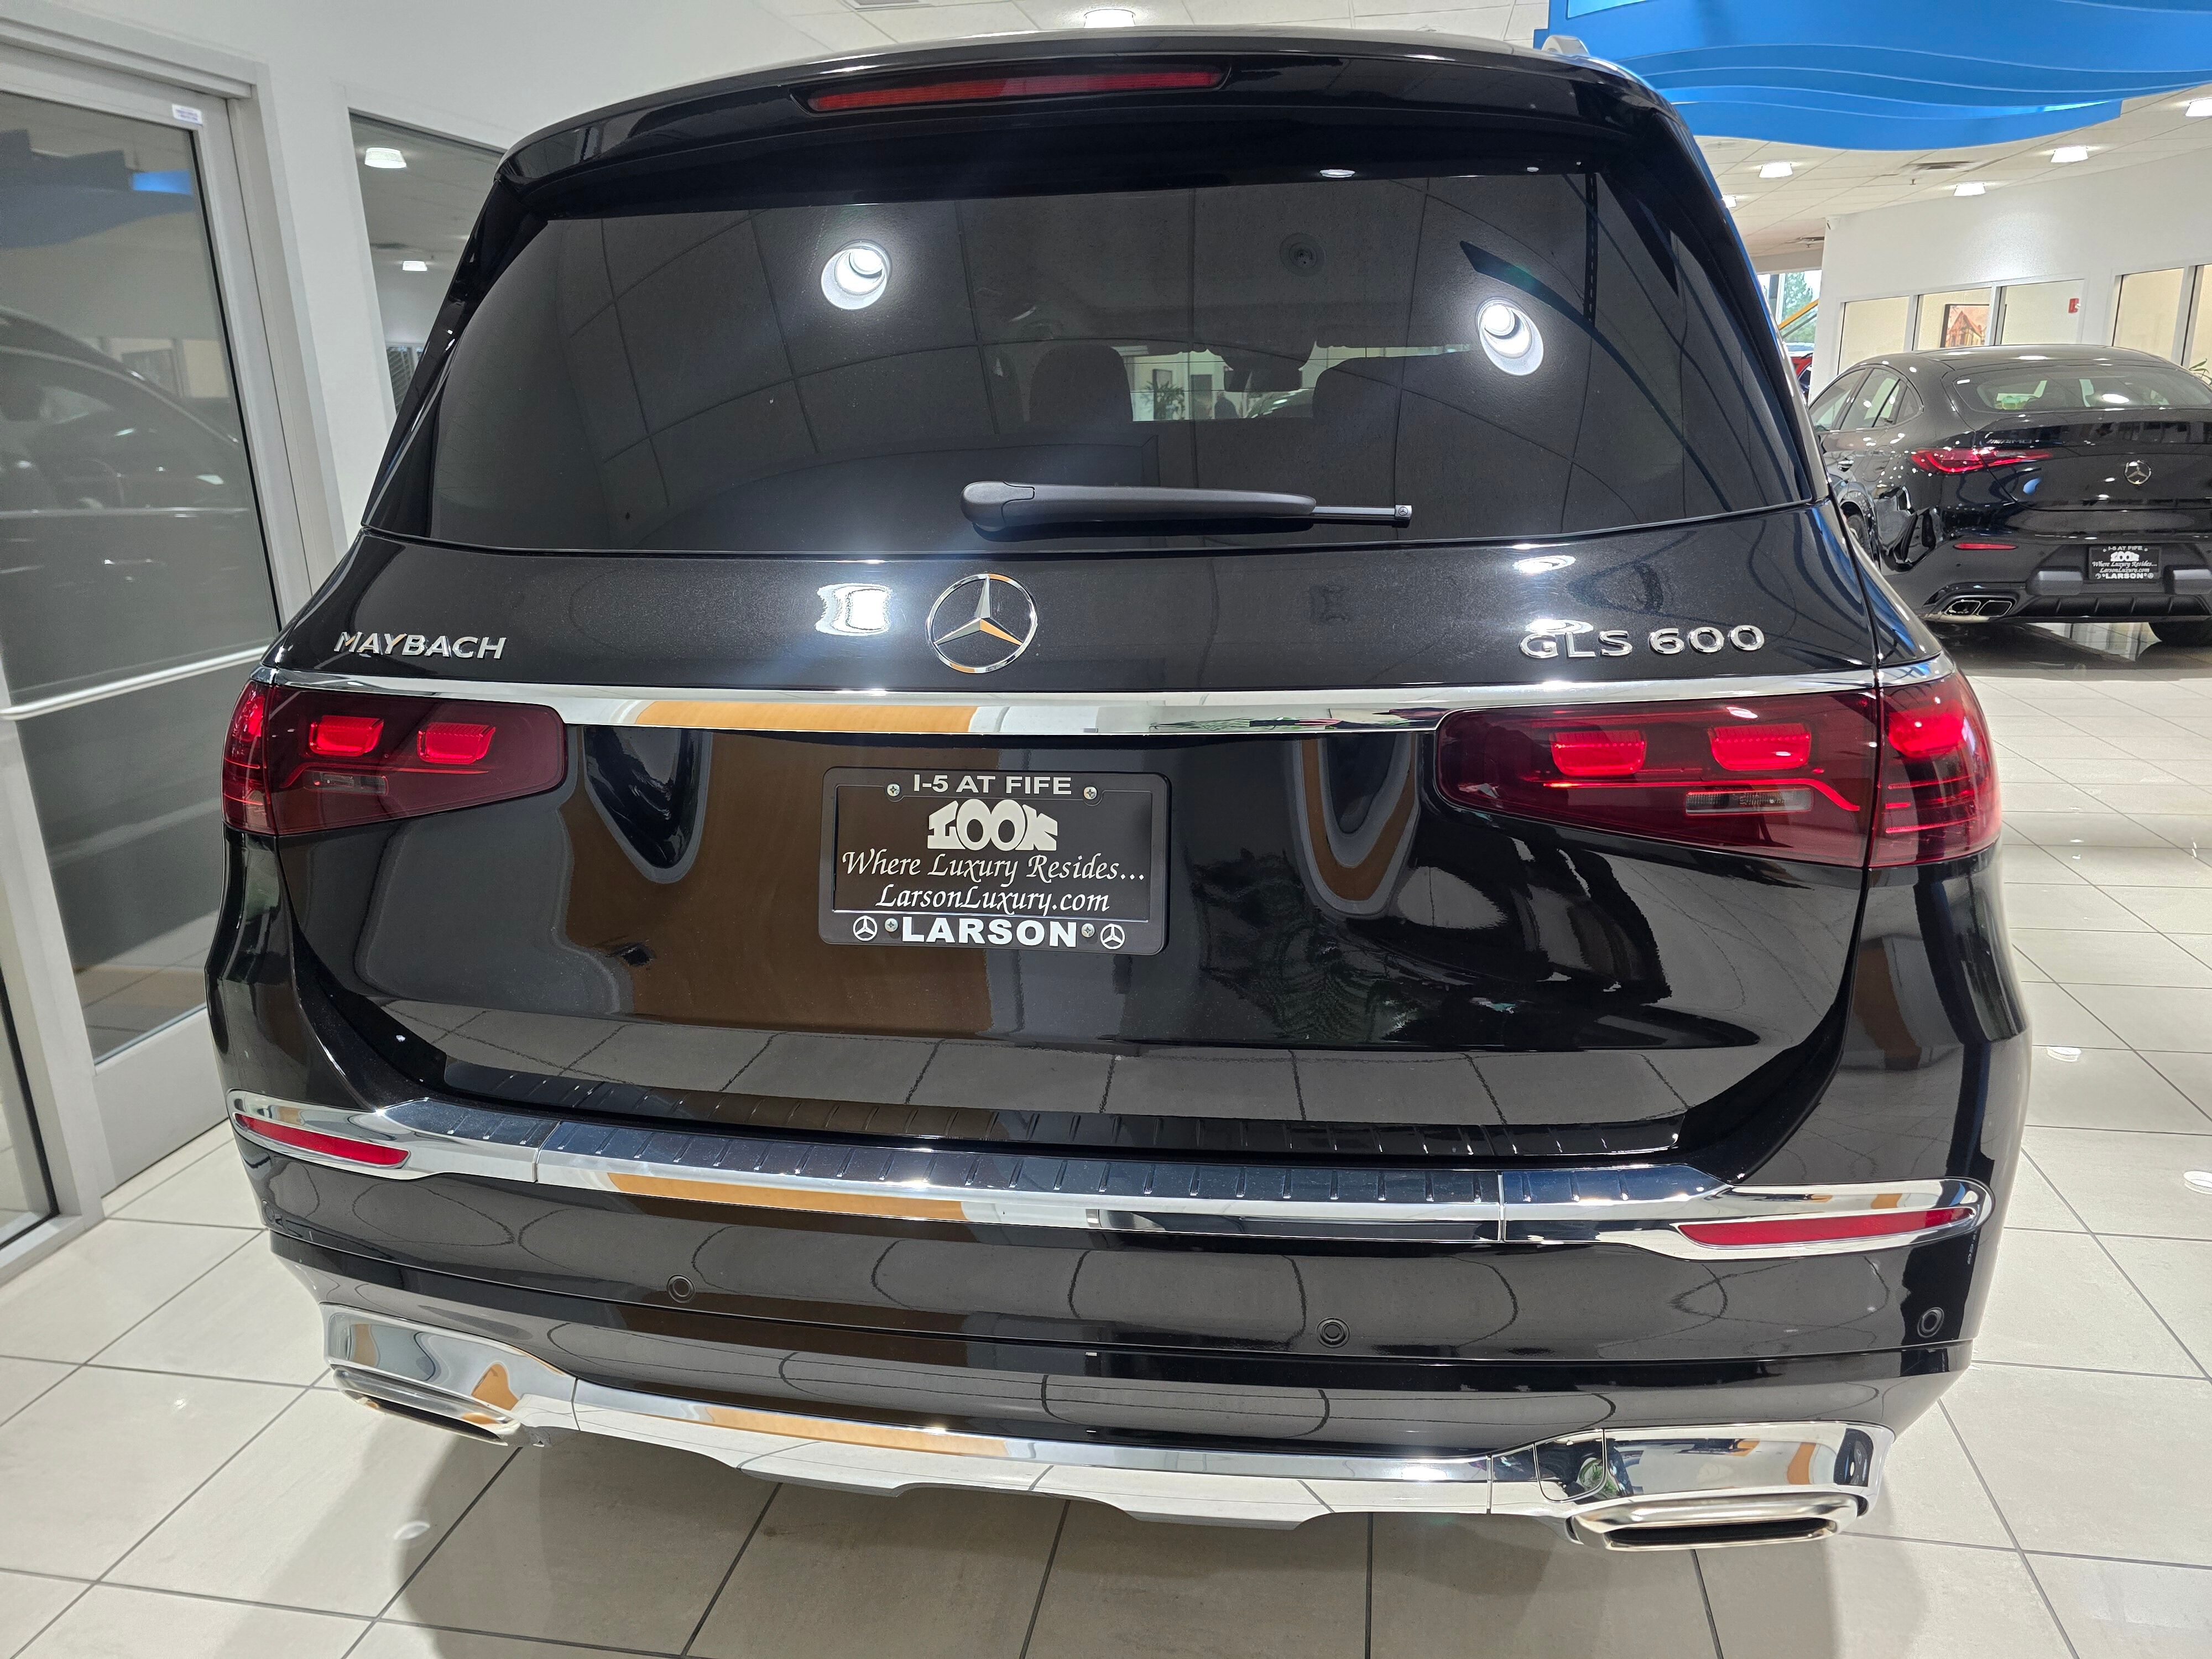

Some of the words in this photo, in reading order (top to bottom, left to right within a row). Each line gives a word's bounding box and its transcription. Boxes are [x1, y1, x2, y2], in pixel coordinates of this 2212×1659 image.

[333, 632, 507, 659] MAYBACH
[1519, 630, 1634, 659] GLS
[1648, 625, 1766, 655] 600
[914, 774, 948, 792] I-5
[956, 775, 996, 794] AT
[1005, 775, 1072, 795] FIFE
[842, 848, 921, 875] Where
[927, 853, 1019, 887] Luxury
[1026, 853, 1145, 884] Resides...
[875, 883, 1110, 916] LarsonLuxury.com
[901, 916, 1077, 948] LARSON
